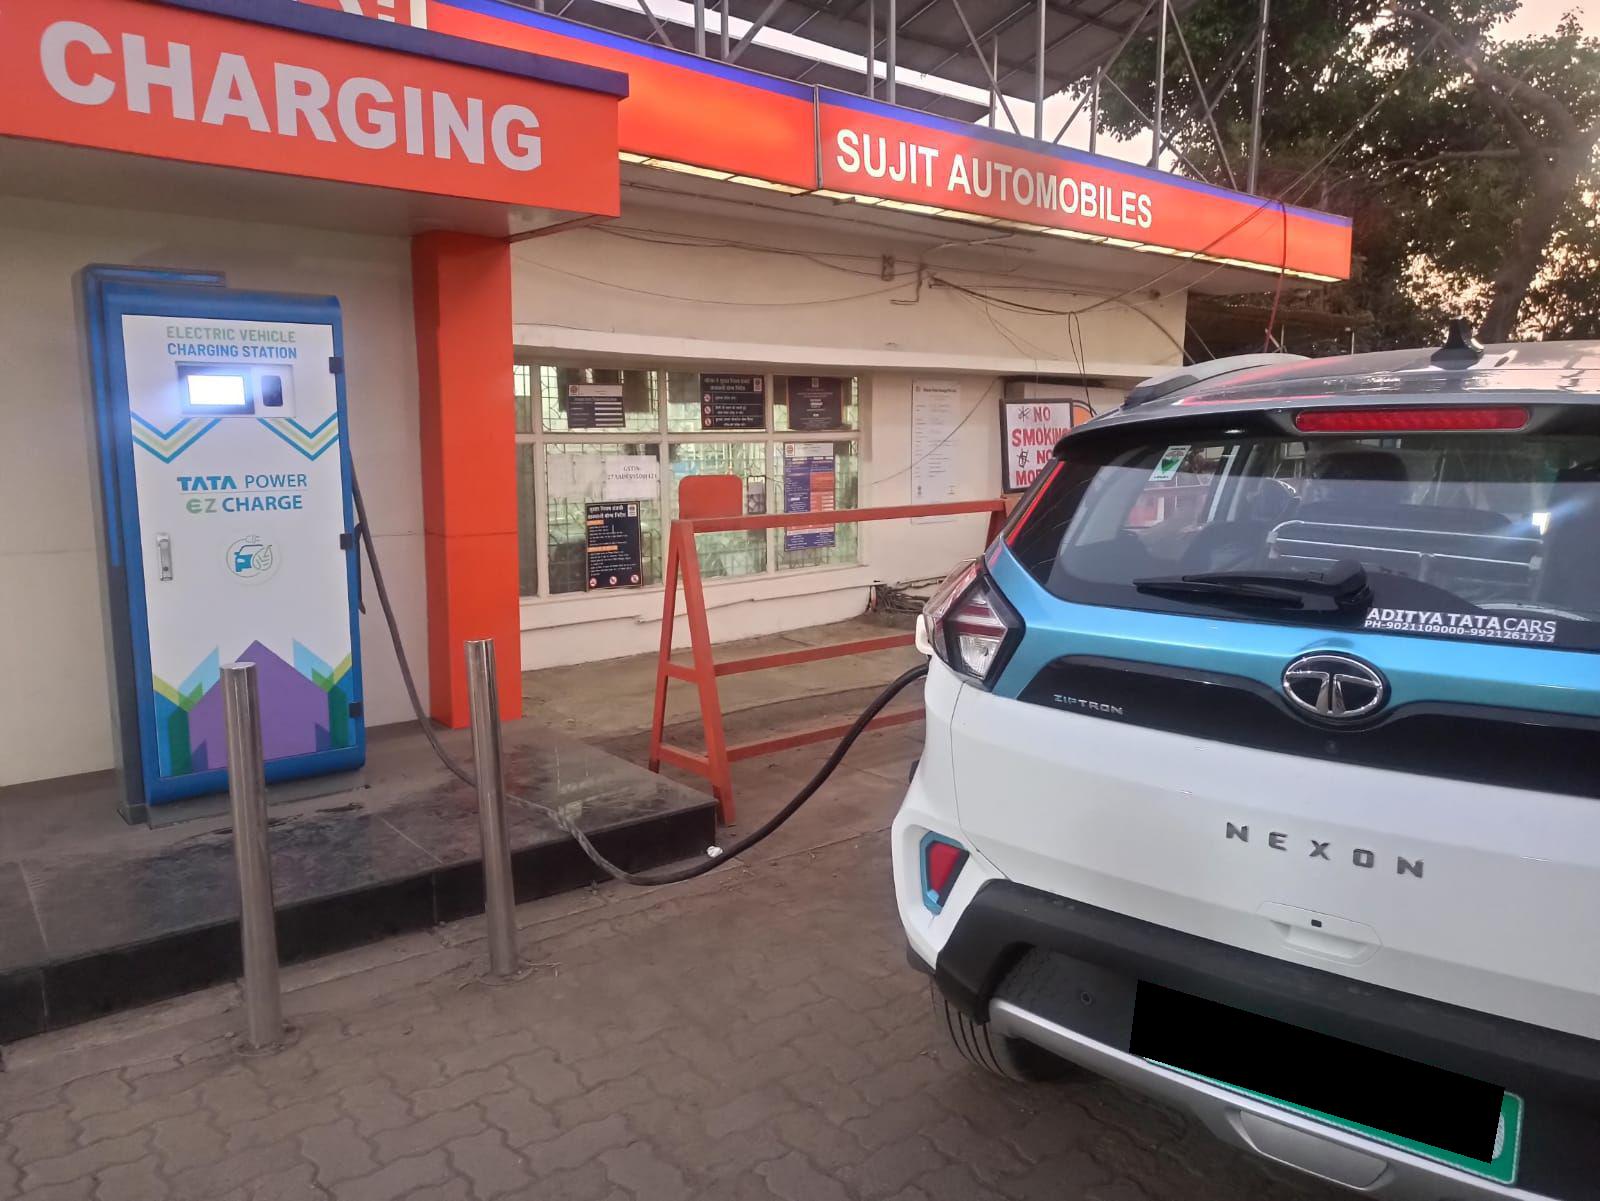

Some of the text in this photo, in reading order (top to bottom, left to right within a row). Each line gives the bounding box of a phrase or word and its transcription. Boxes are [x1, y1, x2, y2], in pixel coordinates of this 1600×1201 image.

[39, 20, 542, 171] CHARGING
[836, 129, 1152, 228] SUJIT AUTOMOBILES
[166, 326, 296, 343] ELECTRIC VEHICLE
[167, 342, 297, 359] CHARGING STATION
[1033, 406, 1051, 422] NO
[177, 474, 308, 491] TATA POWER
[222, 495, 303, 513] CHARGE
[1366, 608, 1556, 635] ADITYA TATA CARS
[1053, 694, 1123, 715] ZIPTRON
[1227, 822, 1424, 878] NEXON
